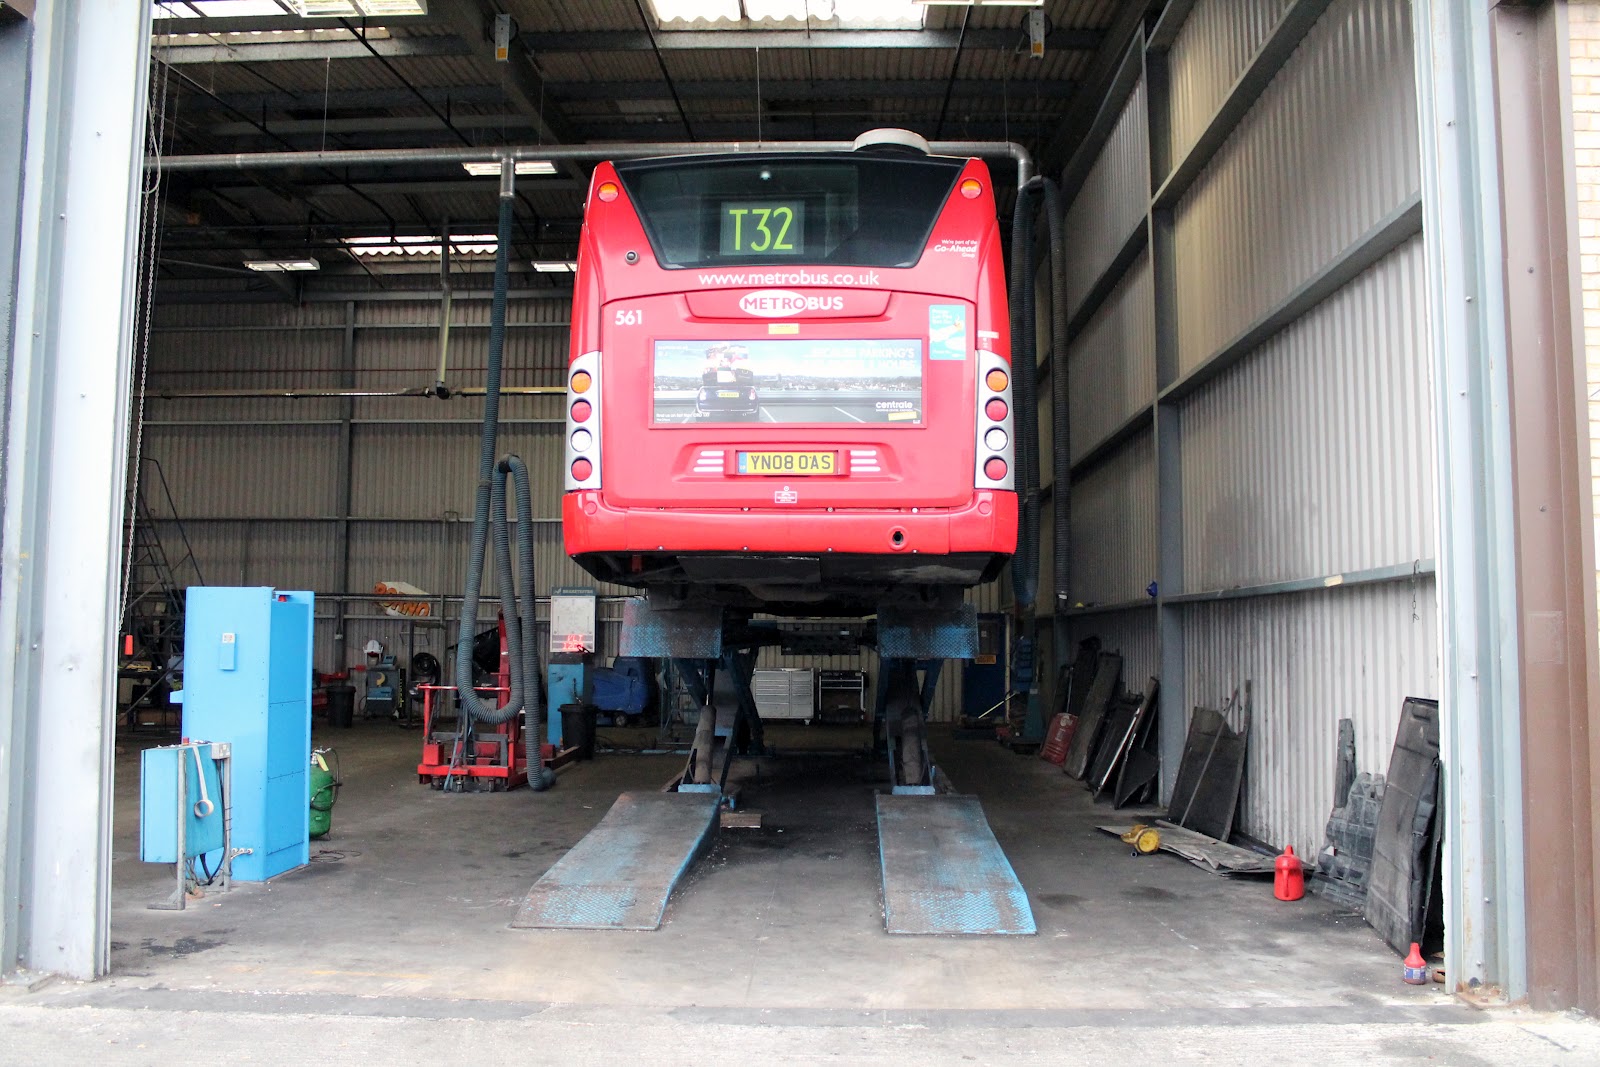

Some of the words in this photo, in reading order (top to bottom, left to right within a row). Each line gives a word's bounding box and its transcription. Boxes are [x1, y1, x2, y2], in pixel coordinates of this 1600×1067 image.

[729, 206, 793, 251] T32
[934, 244, 977, 253] Go-Ahead
[698, 270, 880, 286] www.metrobus.co.uk
[743, 296, 844, 311] METROBUS
[614, 309, 643, 326] 561
[875, 400, 913, 409] centrale
[751, 455, 794, 470] YN08
[799, 455, 832, 470] OAS
